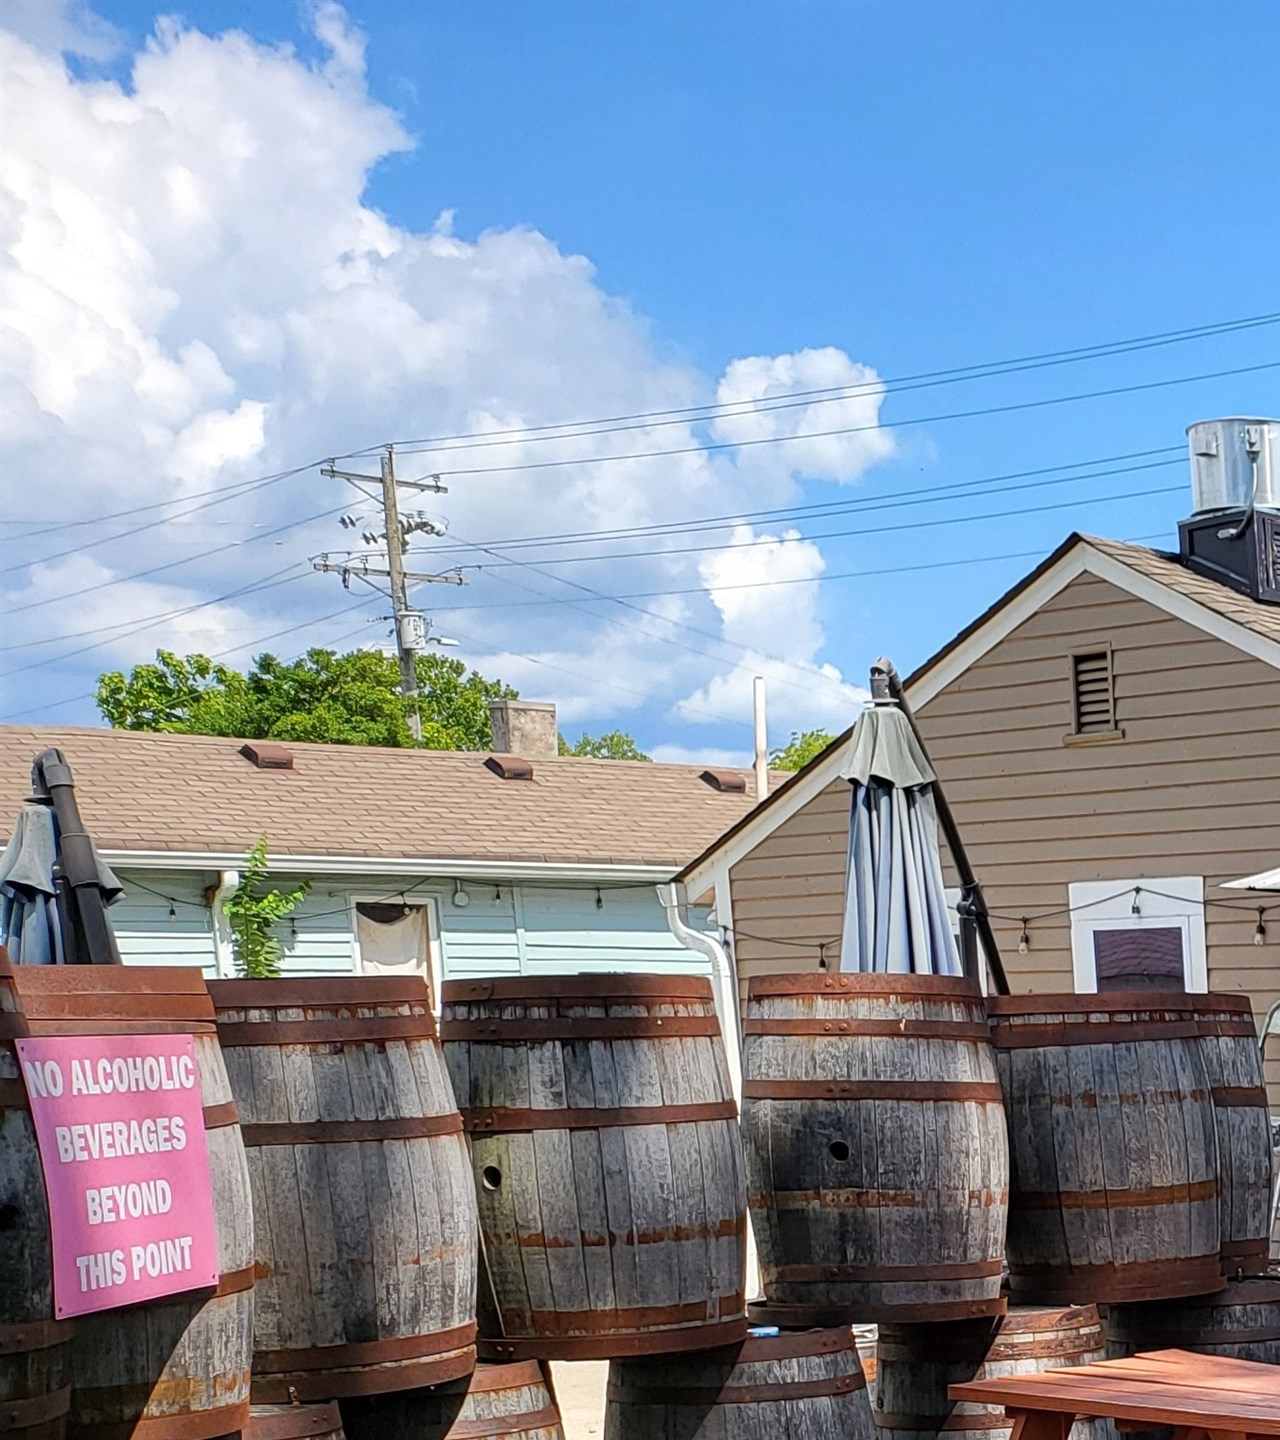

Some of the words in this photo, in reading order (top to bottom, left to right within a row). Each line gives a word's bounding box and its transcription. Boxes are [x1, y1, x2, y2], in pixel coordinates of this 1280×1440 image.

[23, 1060, 64, 1098] NO
[71, 1055, 196, 1096] ALCOHOLIC
[55, 1116, 187, 1163] BEVERAGES
[85, 1179, 172, 1225] BEYOND
[76, 1249, 126, 1292] THIS
[130, 1236, 192, 1281] POINT
